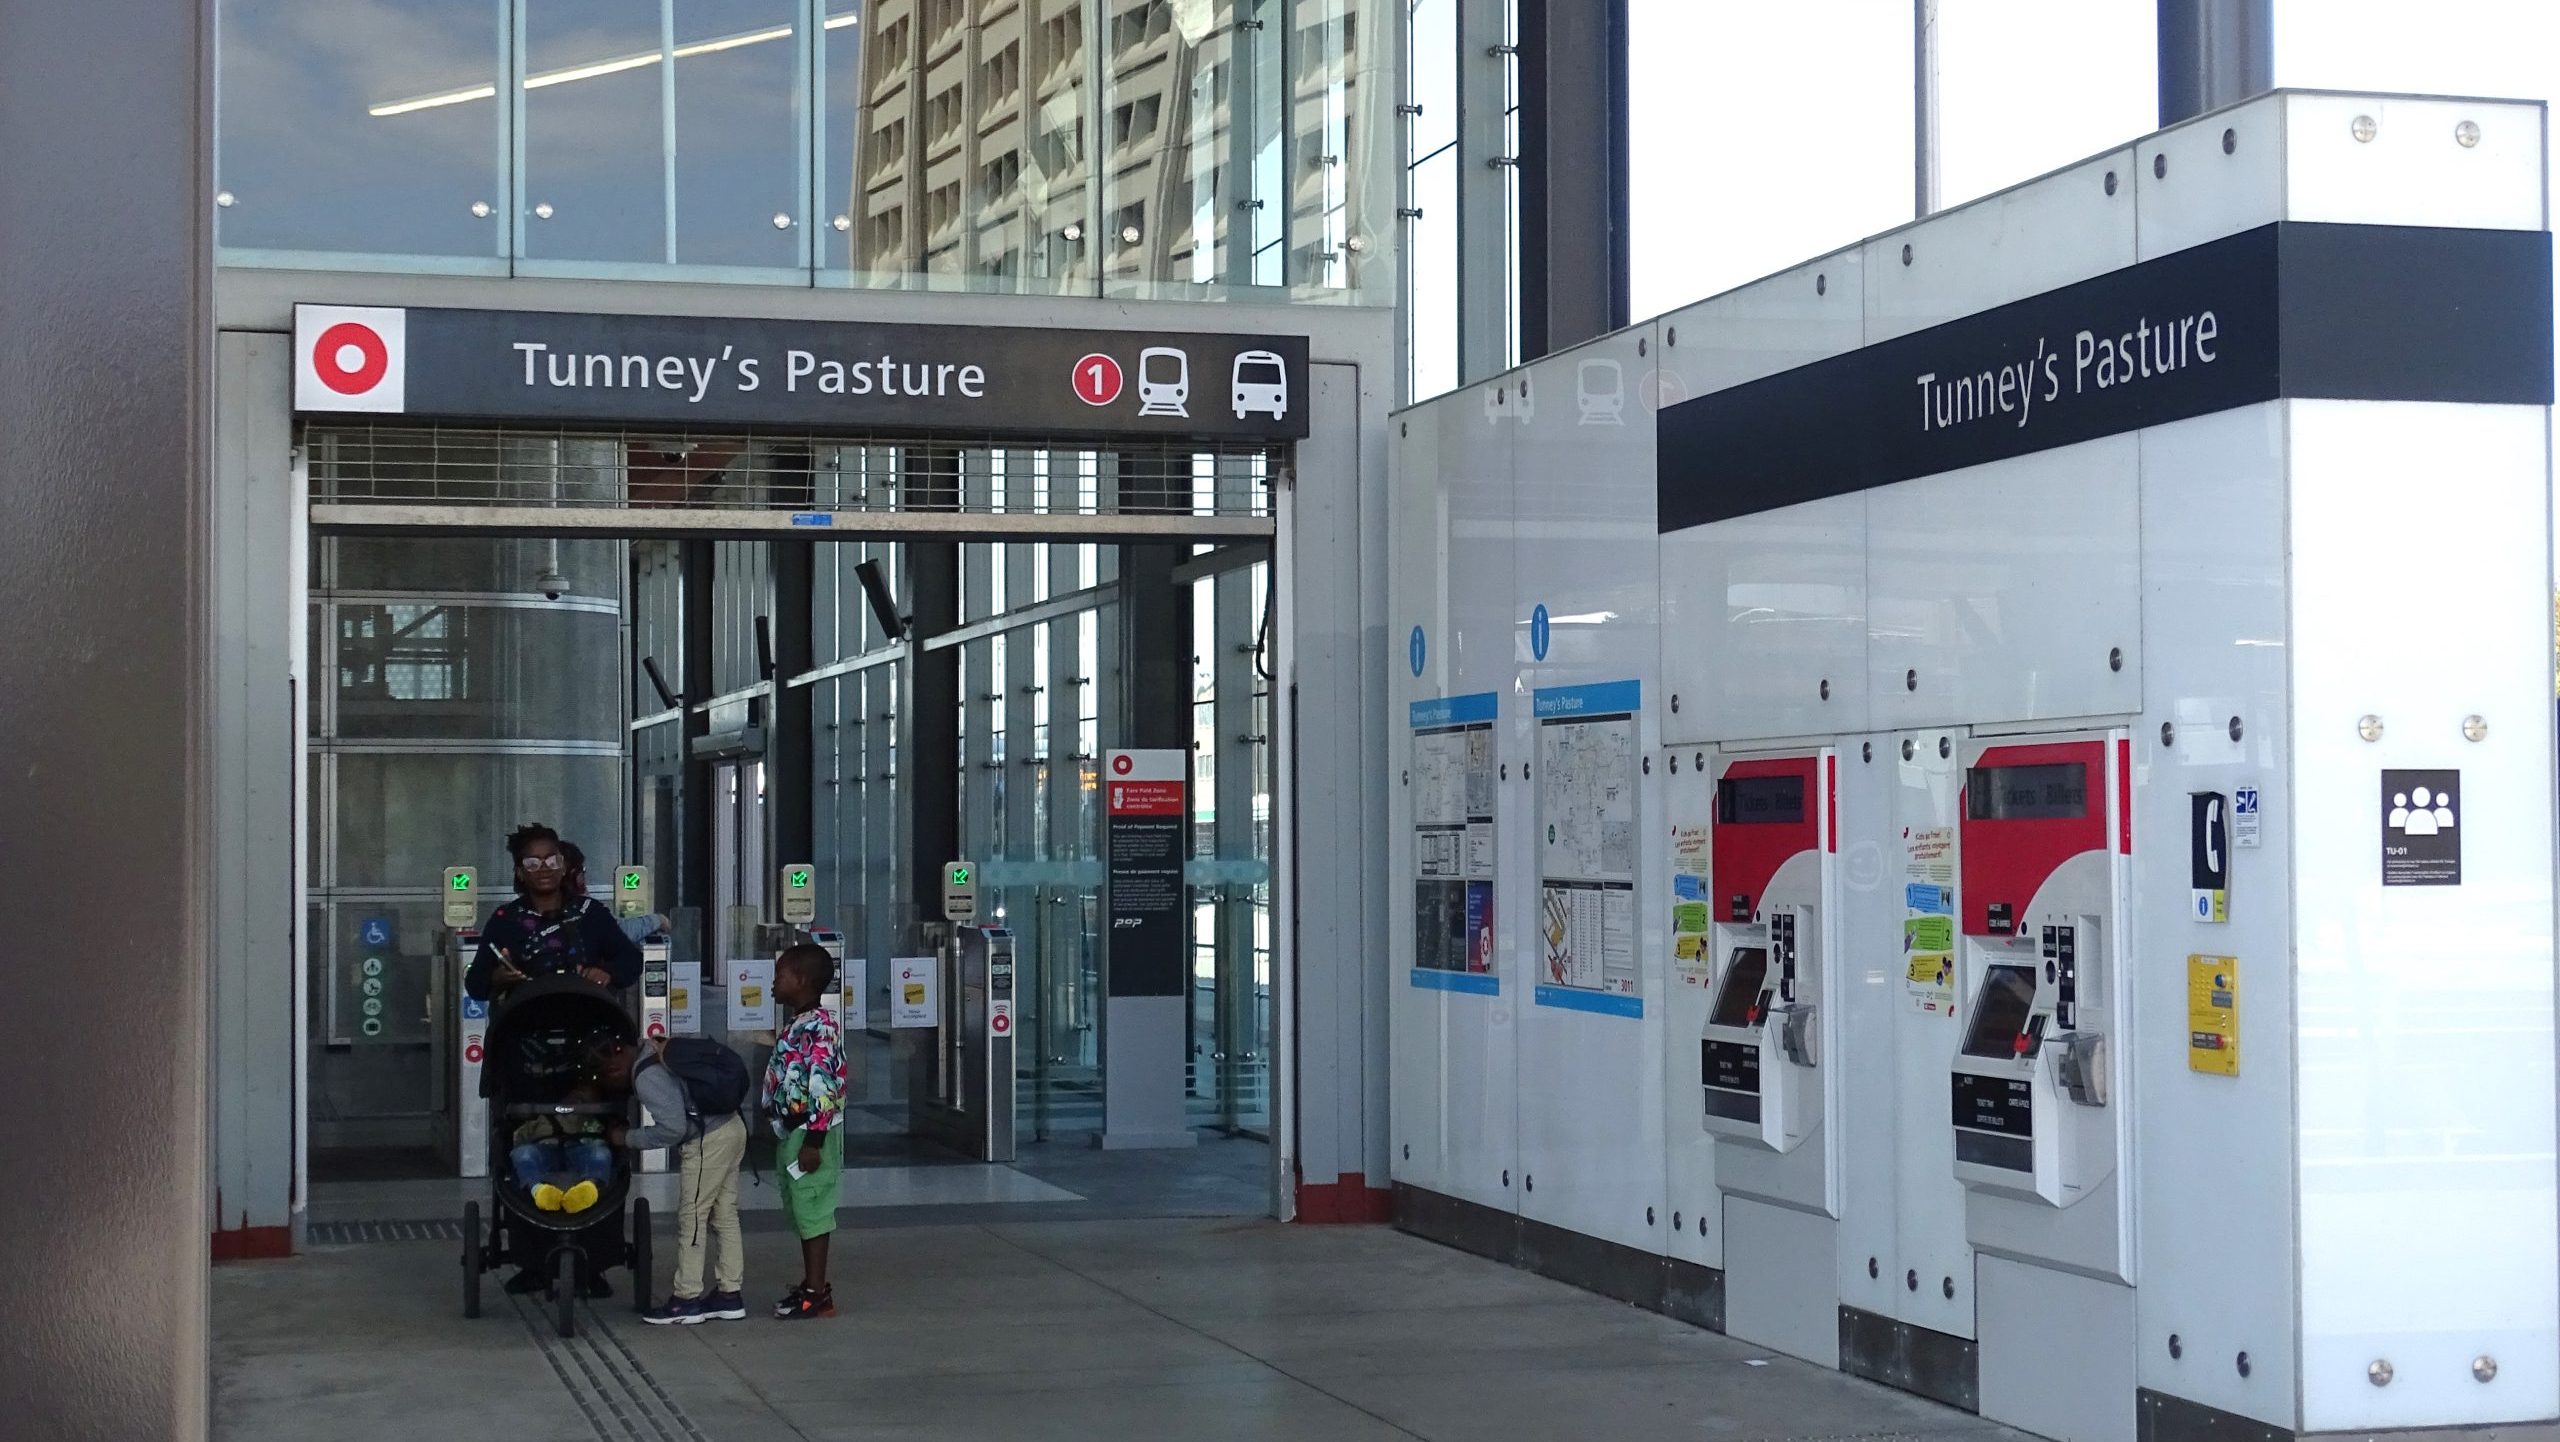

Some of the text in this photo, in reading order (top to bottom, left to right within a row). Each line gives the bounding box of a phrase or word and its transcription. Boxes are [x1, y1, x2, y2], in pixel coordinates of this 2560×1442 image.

[512, 342, 985, 403] Tunney's Pasture
[1087, 363, 1103, 396] 1
[1917, 311, 2217, 431] Tunney's Pasture
[2386, 846, 2408, 856] TU-01
